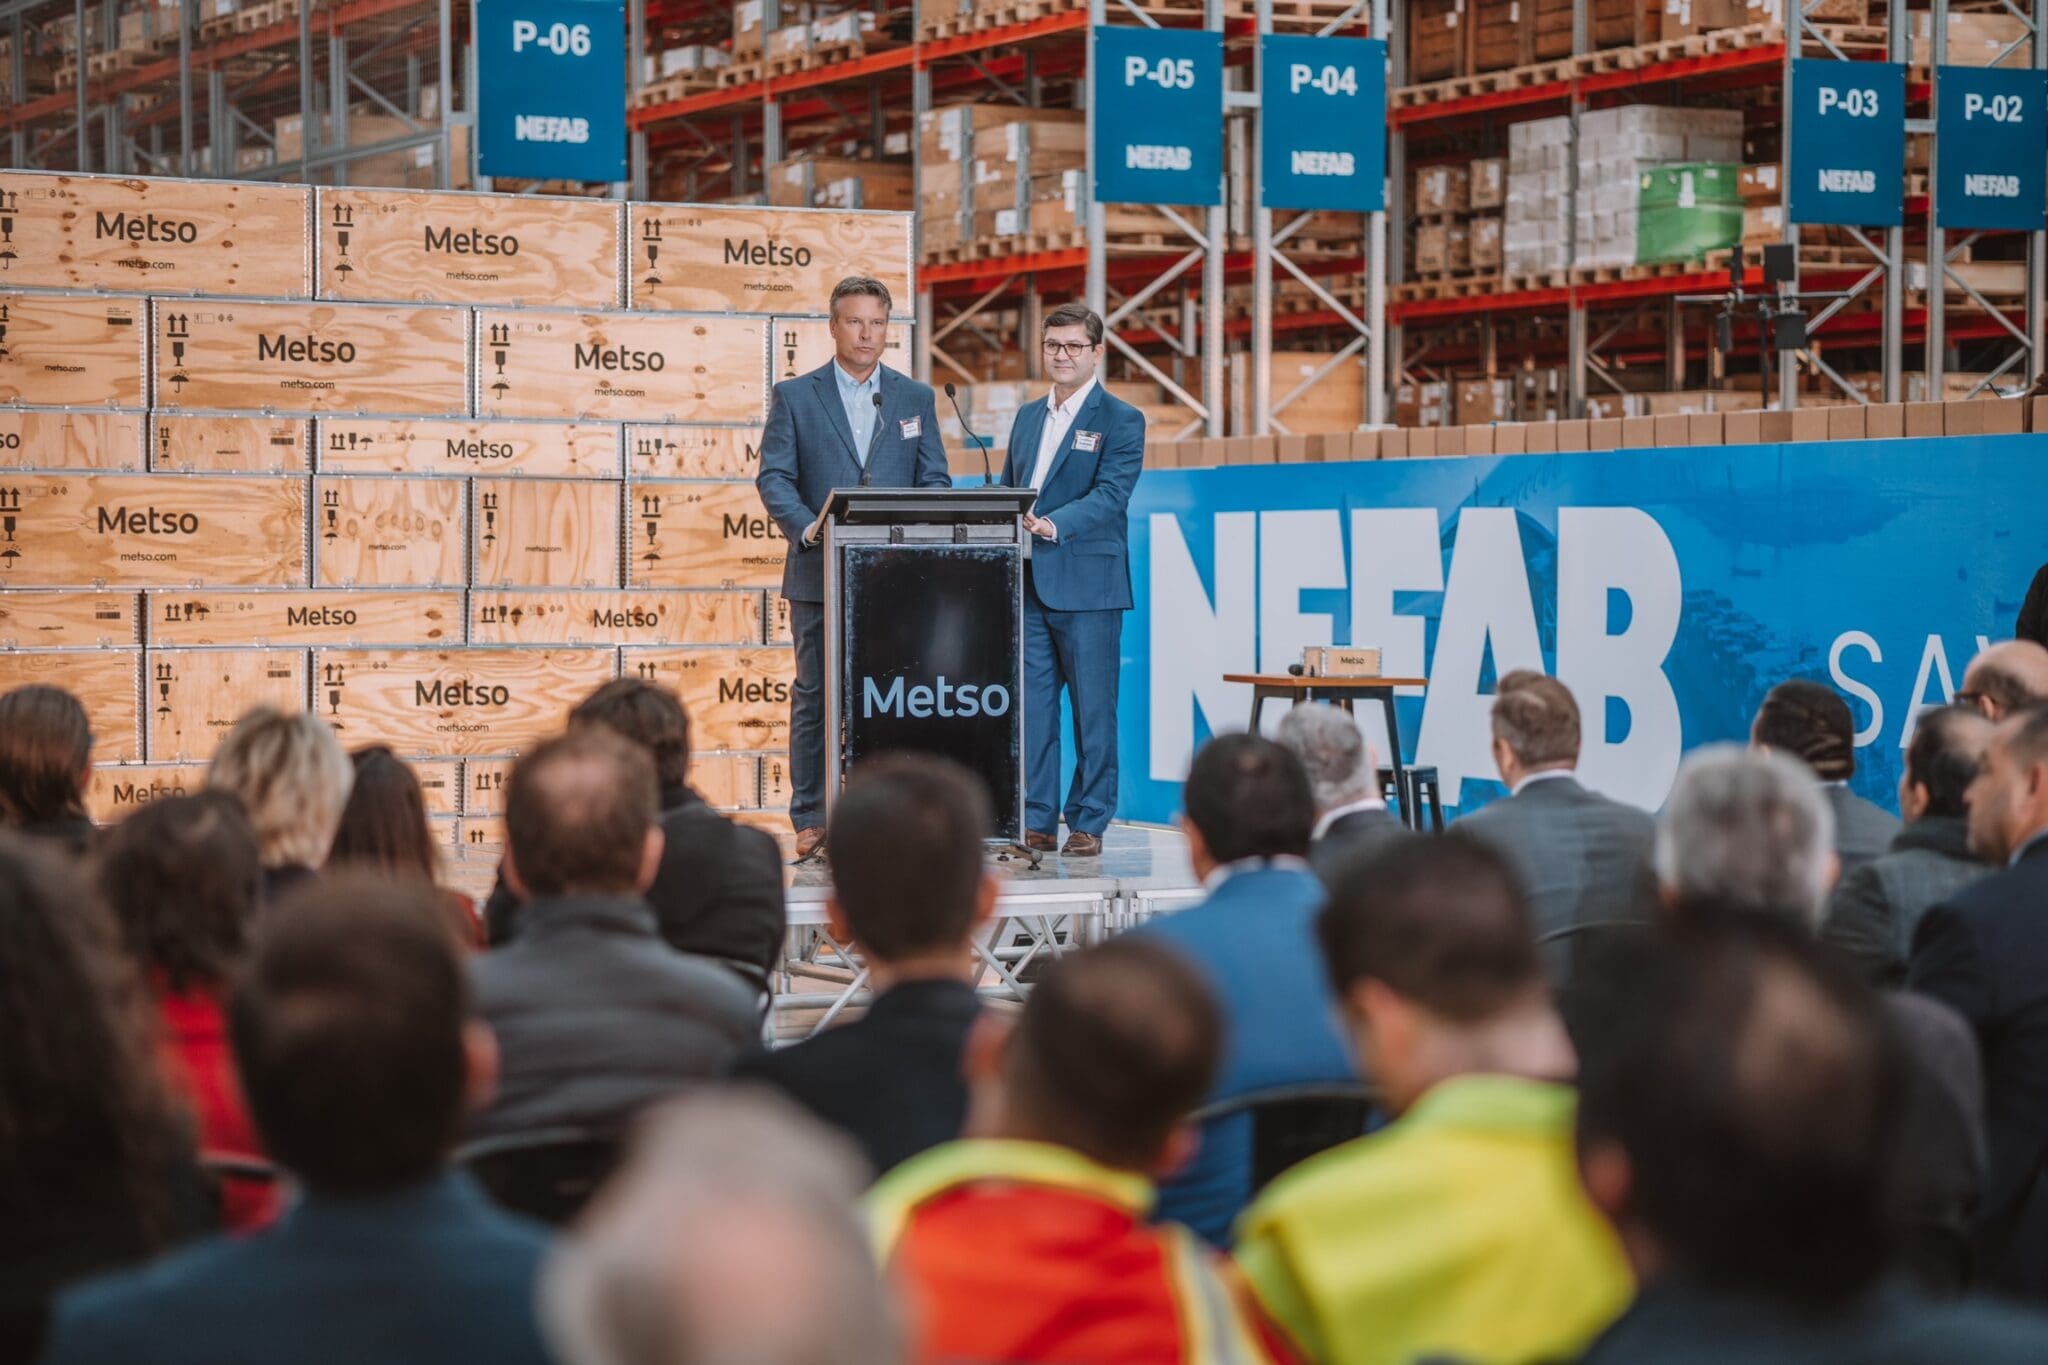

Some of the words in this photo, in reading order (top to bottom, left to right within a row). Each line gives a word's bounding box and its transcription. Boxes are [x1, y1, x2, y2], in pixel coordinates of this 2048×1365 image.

[513, 20, 591, 56] P-06
[1125, 56, 1195, 89] P-05
[1290, 63, 1358, 96] P-04
[1818, 87, 1879, 117] P-03
[1965, 93, 2023, 122] P-02
[515, 115, 590, 143] NEFAB
[1126, 144, 1192, 170] NEFAB
[1291, 150, 1355, 176] NEFAB
[1818, 169, 1876, 193] NEFAB
[1964, 174, 2020, 197] NEFAB
[95, 211, 198, 243] Metso
[425, 225, 519, 256] Metso
[724, 238, 812, 267] Metso
[117, 258, 176, 270] metso.com
[446, 270, 499, 281] metso.com
[743, 282, 794, 293] metso.com
[258, 333, 356, 363] Metso
[575, 342, 665, 372] Metso
[44, 364, 86, 373] metso.com
[280, 379, 335, 390] metso.com
[594, 386, 646, 397] metso.com
[446, 438, 514, 459] Metso
[97, 506, 199, 535] Metso
[120, 551, 177, 562] metso.com
[368, 543, 407, 551] metso.com
[287, 605, 357, 627] Metso
[592, 608, 659, 628] Metso
[1339, 655, 1366, 666] Metso
[415, 679, 510, 707] Metso
[718, 676, 793, 704] Mets
[863, 675, 1011, 719] Metso
[1827, 630, 1990, 749] SA
[436, 722, 490, 733] metso.com
[737, 719, 787, 729] metso.com
